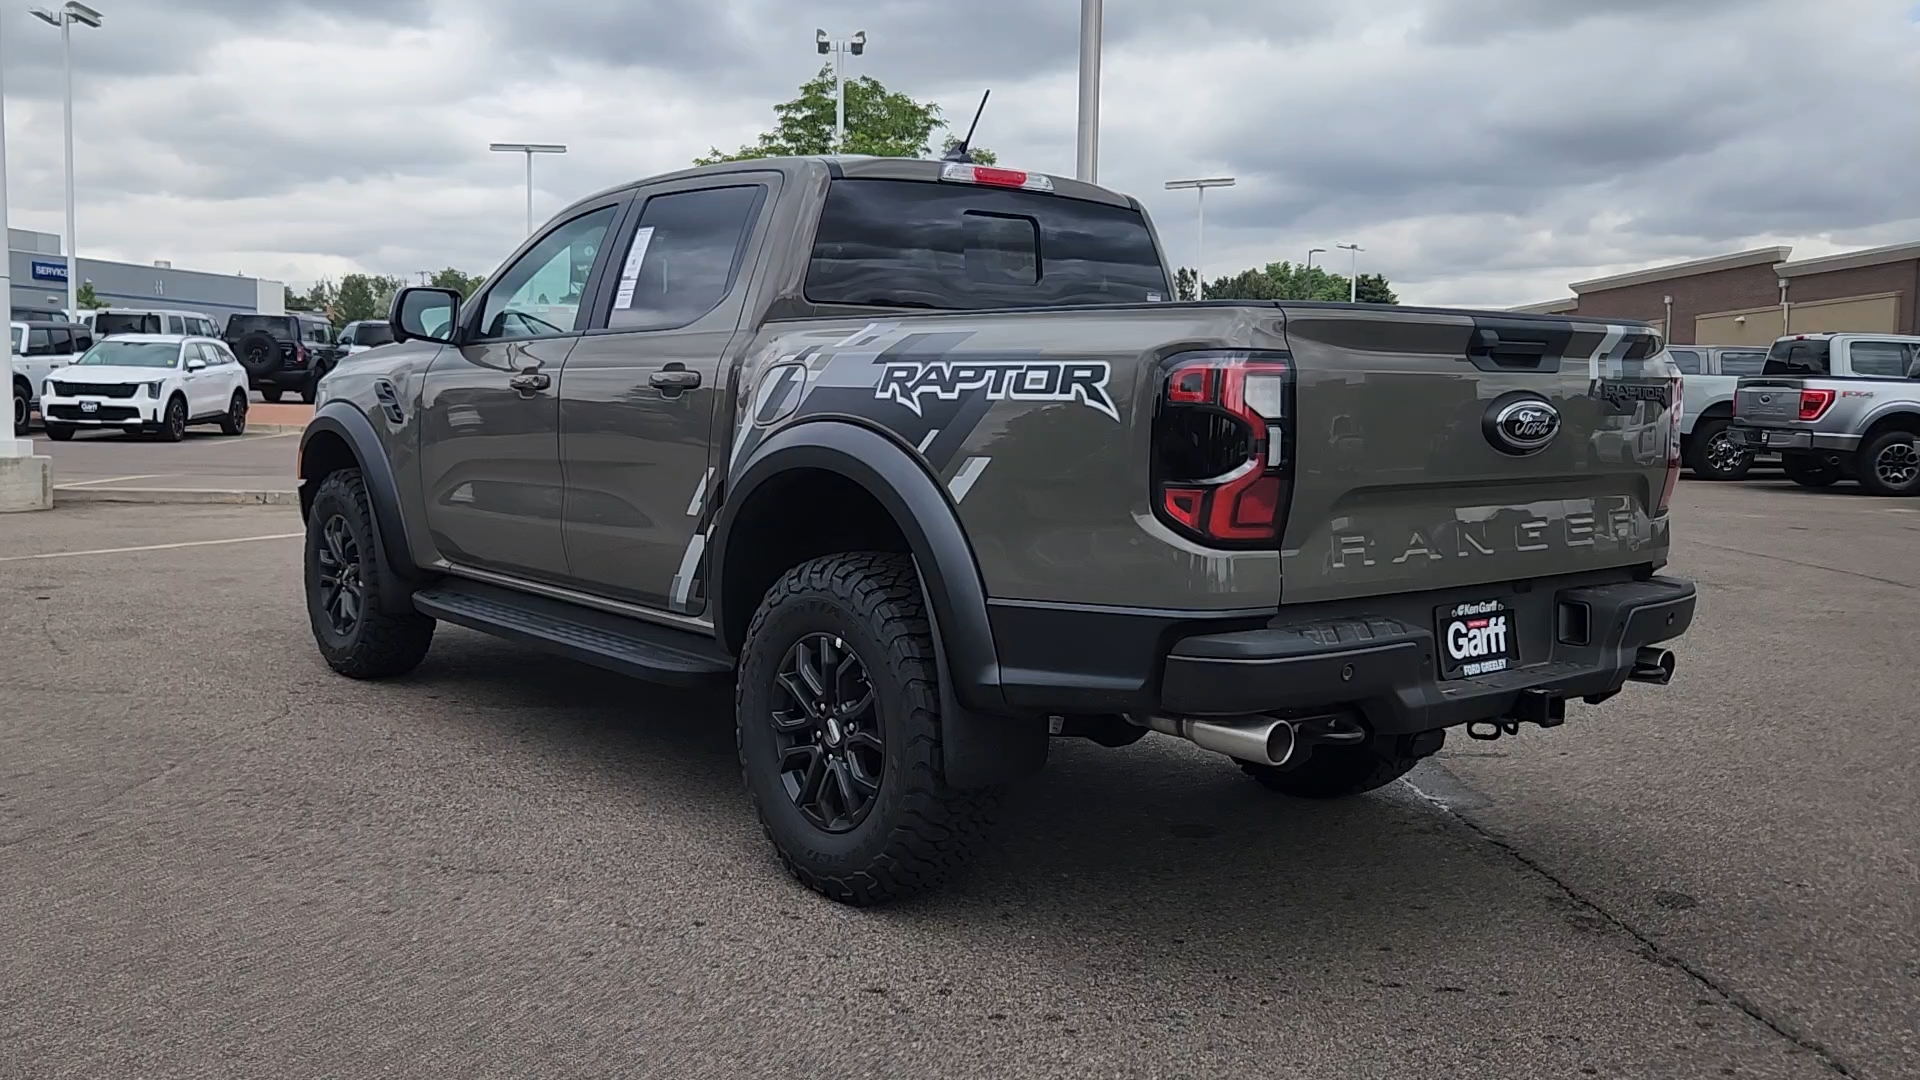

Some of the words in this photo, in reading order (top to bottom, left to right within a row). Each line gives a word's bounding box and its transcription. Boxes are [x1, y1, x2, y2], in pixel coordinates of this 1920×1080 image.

[875, 360, 1121, 423] RAPTOR
[1604, 383, 1669, 411] RAPTOR
[1515, 410, 1551, 435] Ford
[1332, 495, 1637, 568] RANGER
[1464, 604, 1478, 615] Ken
[1479, 600, 1497, 613] Garff
[1447, 616, 1506, 659] Garff
[1463, 663, 1480, 675] FORD
